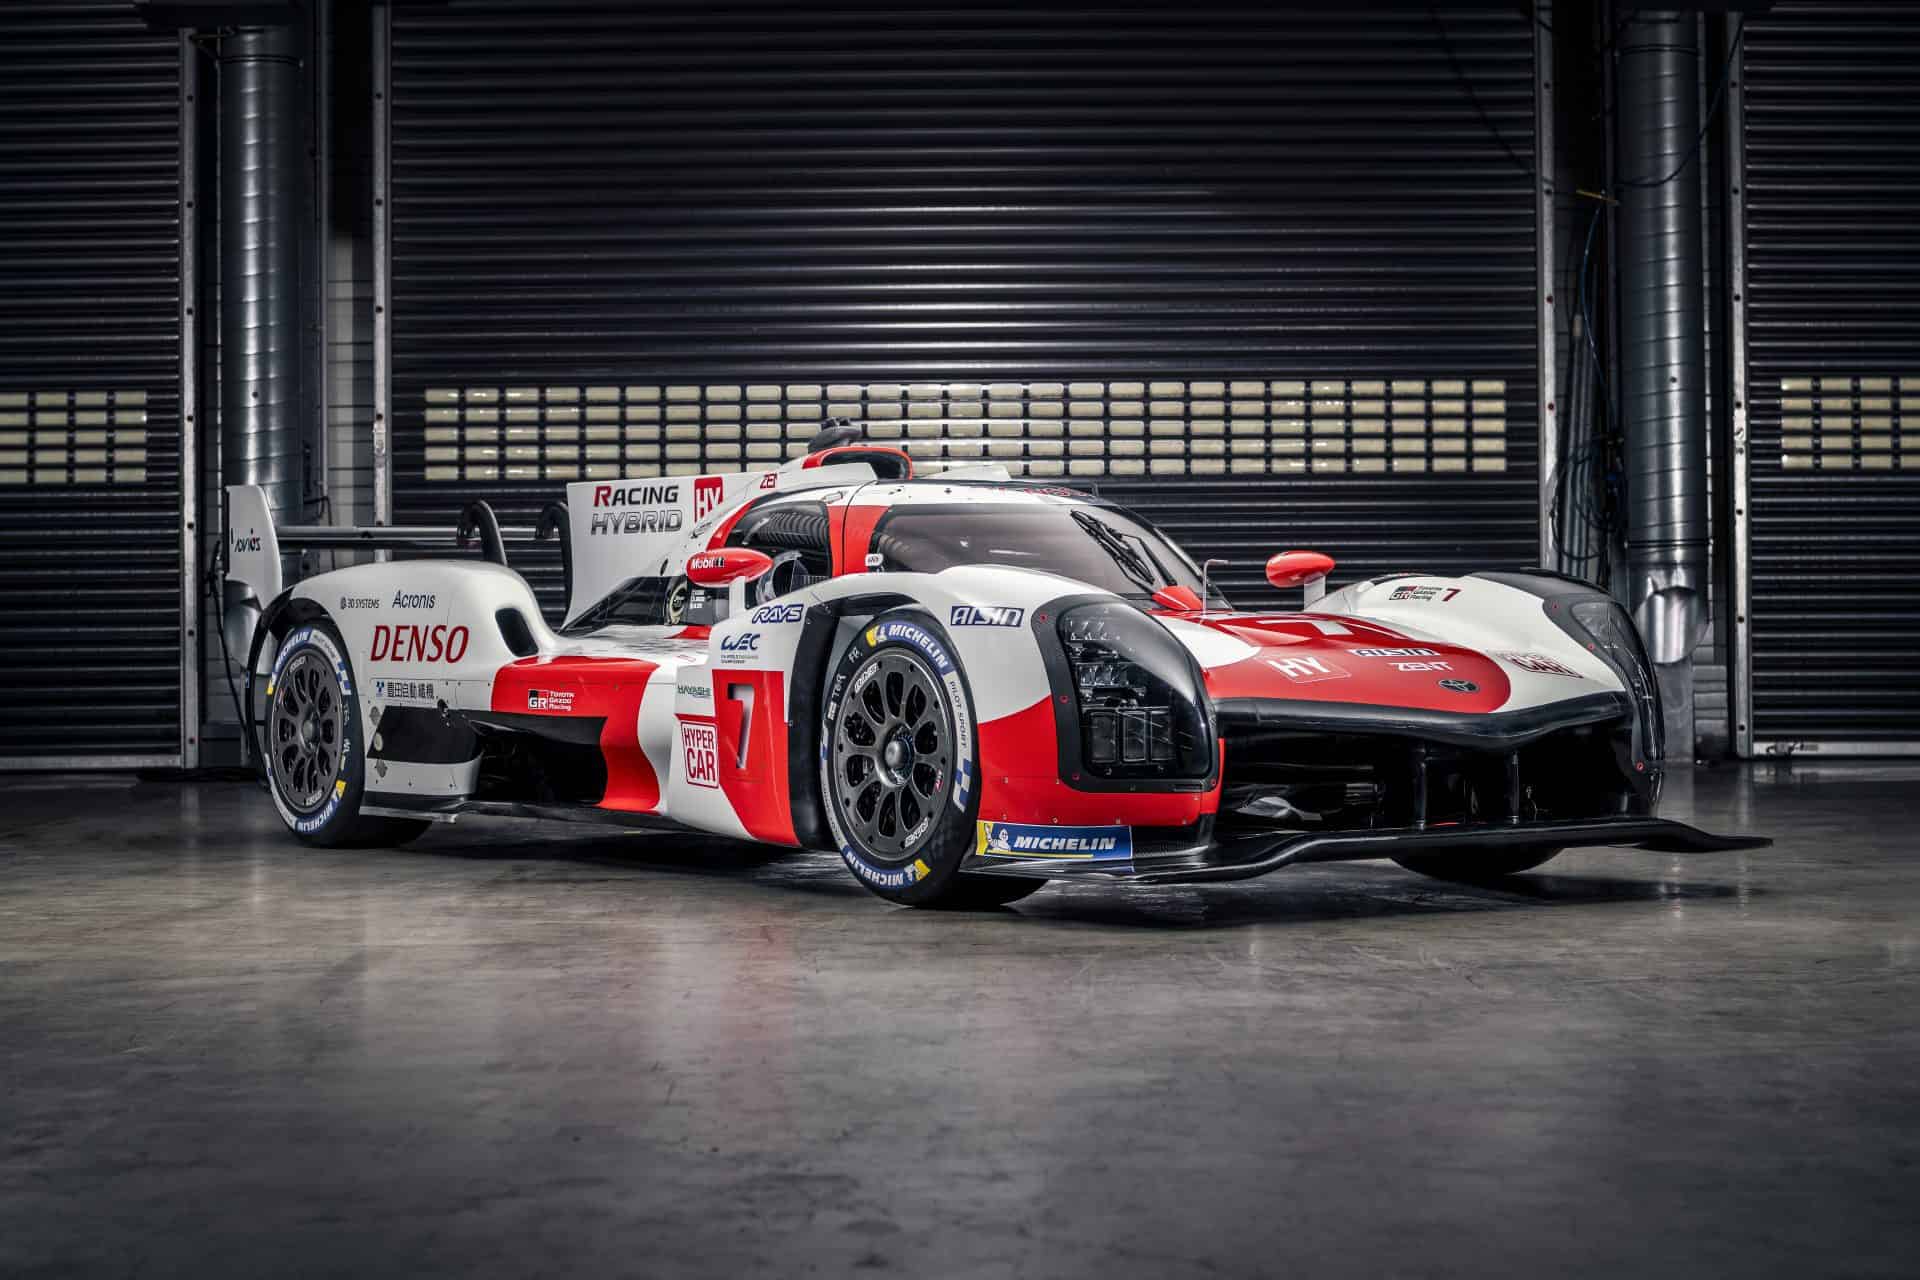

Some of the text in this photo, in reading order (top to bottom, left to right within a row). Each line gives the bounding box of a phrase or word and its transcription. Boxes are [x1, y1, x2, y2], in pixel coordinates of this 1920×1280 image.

[593, 485, 679, 507] RACING
[590, 509, 683, 535] HYBRID
[355, 598, 380, 609] SYSTEMS
[391, 589, 436, 609] Acronis
[1441, 587, 1462, 602] 7
[751, 603, 805, 625] RAYS
[950, 607, 1021, 626] AISIN
[370, 624, 470, 664] DENSO
[720, 632, 761, 651] WEC
[889, 624, 948, 668] MICHELIN
[1265, 656, 1331, 678] HY
[727, 682, 756, 770] 7
[683, 726, 715, 750] HYPER
[686, 746, 716, 782] CAR
[1014, 835, 1117, 851] MICHELIN
[845, 851, 904, 887] MICHELIN
